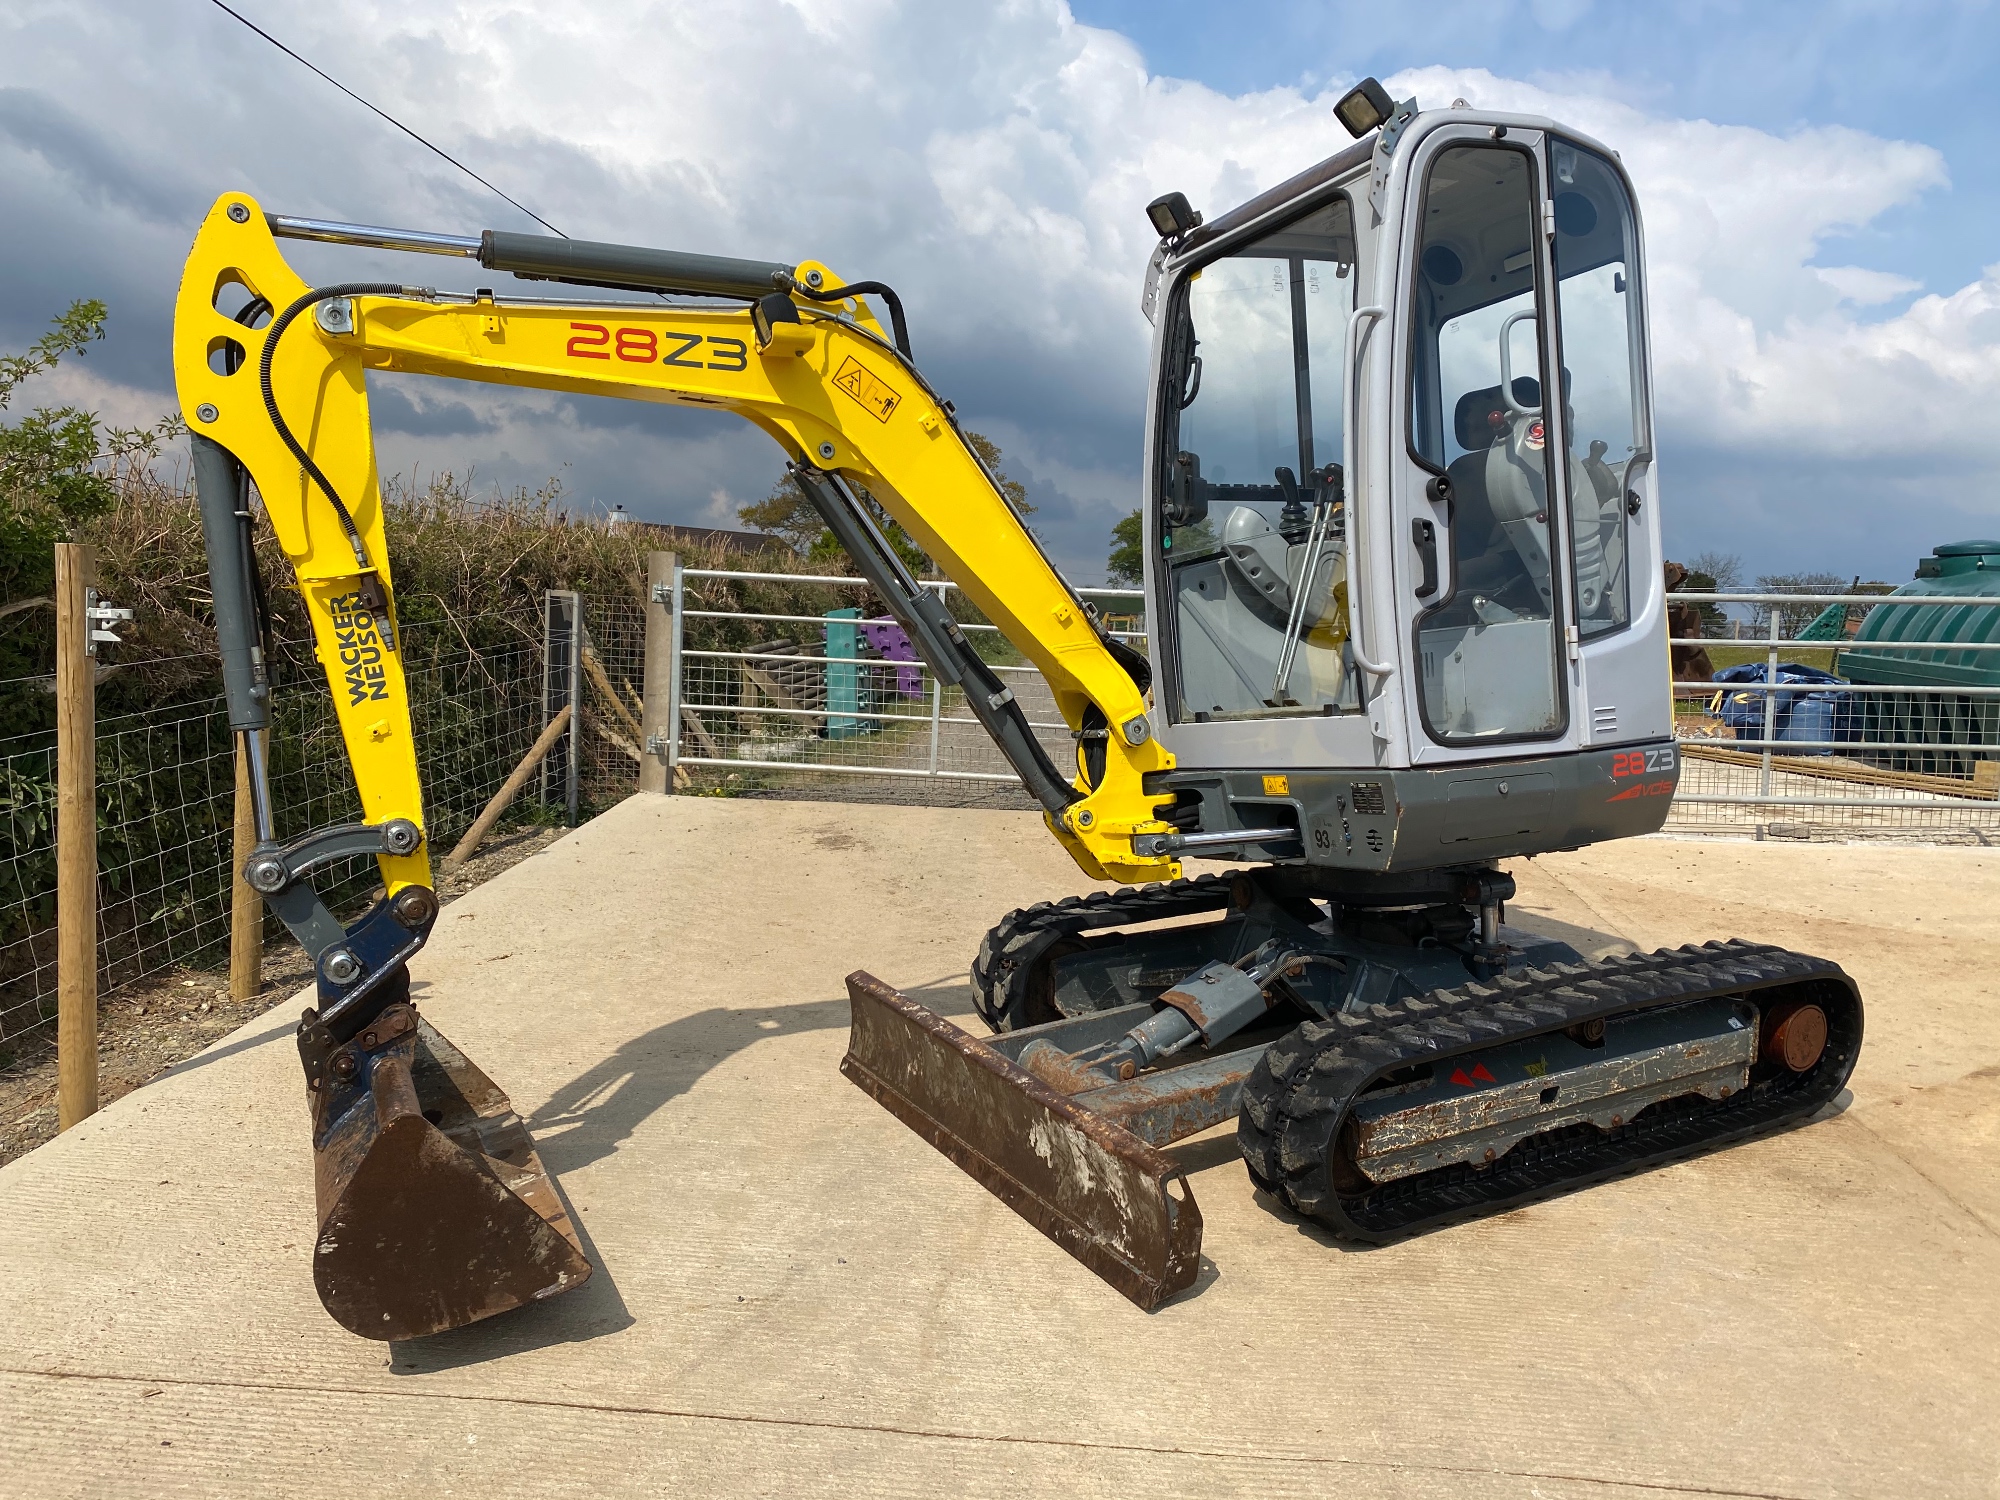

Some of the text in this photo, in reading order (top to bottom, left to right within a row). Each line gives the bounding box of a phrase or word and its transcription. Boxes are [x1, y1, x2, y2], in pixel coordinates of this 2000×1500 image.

[567, 322, 747, 372] 28Z3
[330, 593, 368, 707] WACKER
[1613, 749, 1675, 777] 28Z3
[1315, 829, 1330, 849] 93
